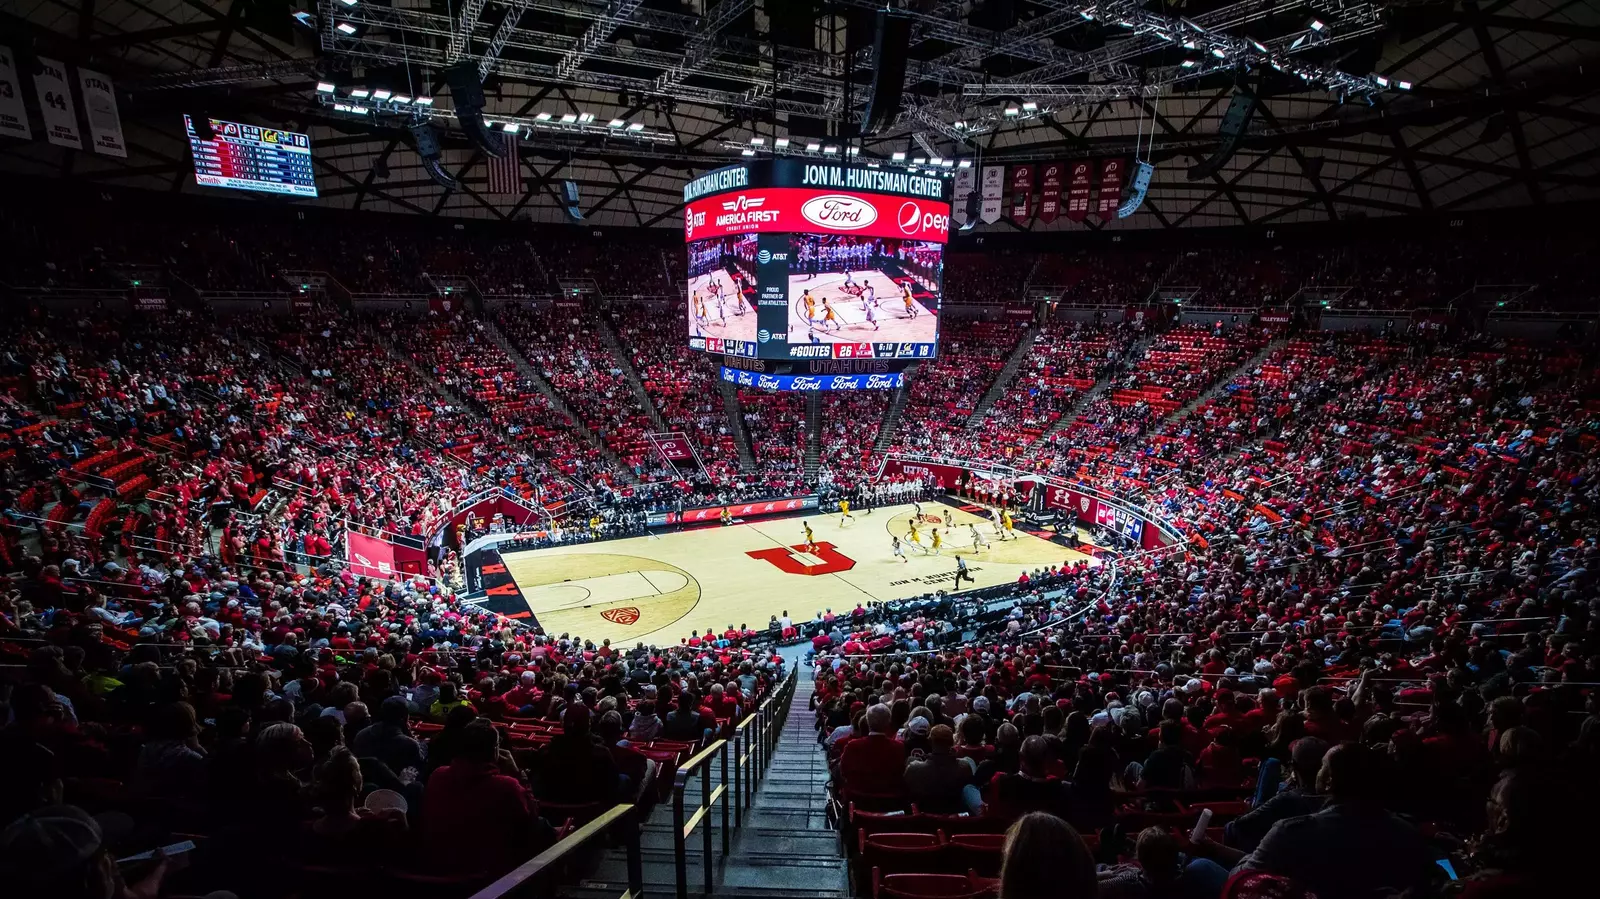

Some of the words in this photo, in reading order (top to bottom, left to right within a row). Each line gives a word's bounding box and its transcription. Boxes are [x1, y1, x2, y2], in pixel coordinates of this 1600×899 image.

[85, 78, 110, 94] UTAH
[45, 91, 66, 111] 44
[294, 136, 306, 148] 18
[719, 167, 746, 190] CENTER
[802, 165, 828, 185] JON
[830, 167, 845, 188] M.
[847, 168, 908, 194] HUNTSMAN
[909, 176, 942, 198] CENTER
[716, 212, 746, 227] AMERICA
[747, 210, 780, 223] FIRST
[819, 200, 862, 222] Ford
[693, 211, 706, 228] AT&T
[1266, 229, 1275, 238] tt
[790, 346, 830, 358] #GOUTES
[839, 346, 852, 357] 26
[919, 346, 929, 356] 18
[742, 358, 765, 372] UTES
[810, 360, 851, 374] UTAH
[855, 360, 890, 372] UTES
[738, 370, 753, 386] Ford
[758, 374, 780, 389] Ford
[790, 376, 821, 390] Ford
[831, 375, 860, 390] Ford
[866, 374, 893, 389] Ford
